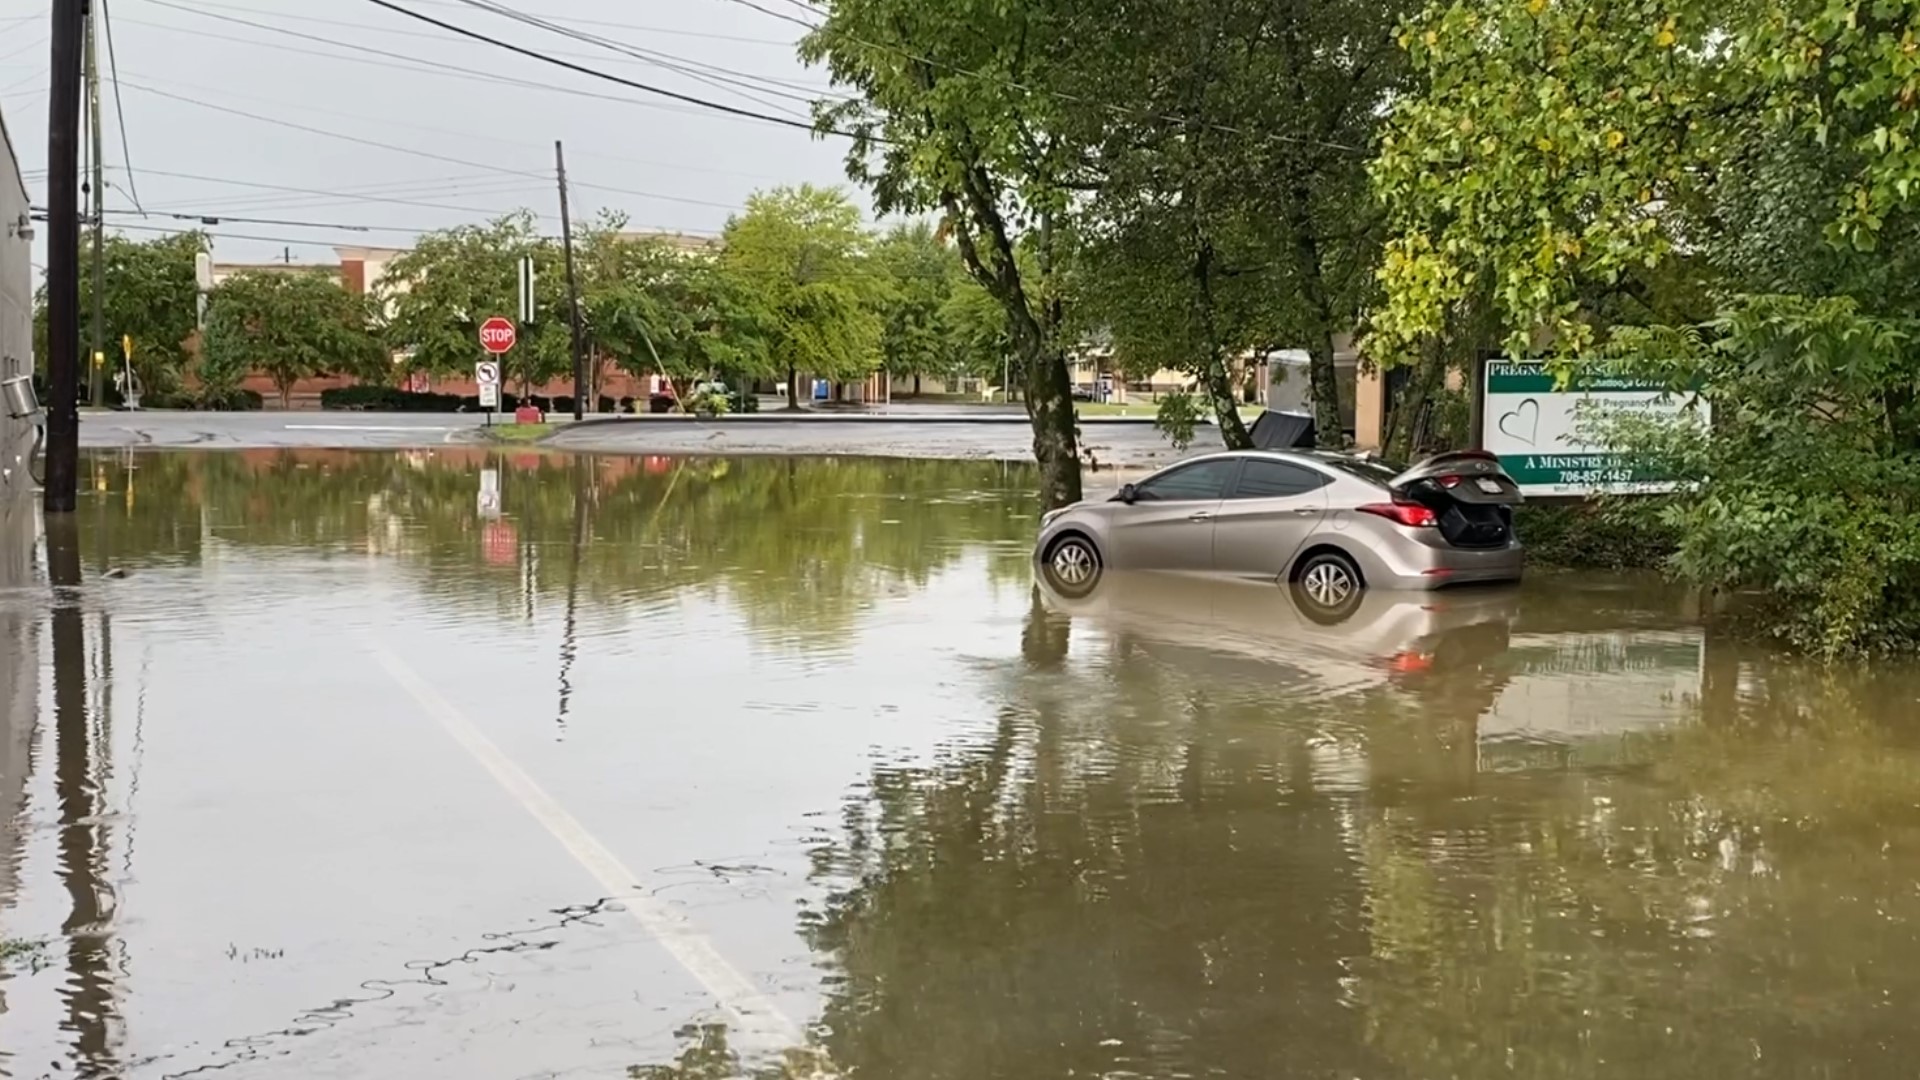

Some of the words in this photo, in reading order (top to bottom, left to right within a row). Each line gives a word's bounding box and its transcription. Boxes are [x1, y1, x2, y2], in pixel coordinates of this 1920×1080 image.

[482, 328, 512, 342] STOP
[1490, 363, 1548, 376] PREGN
[1603, 398, 1649, 409] Pregnancy
[1525, 456, 1535, 469] A
[1539, 456, 1604, 469] MINISTRY
[1559, 469, 1633, 482] 706-857-1457
